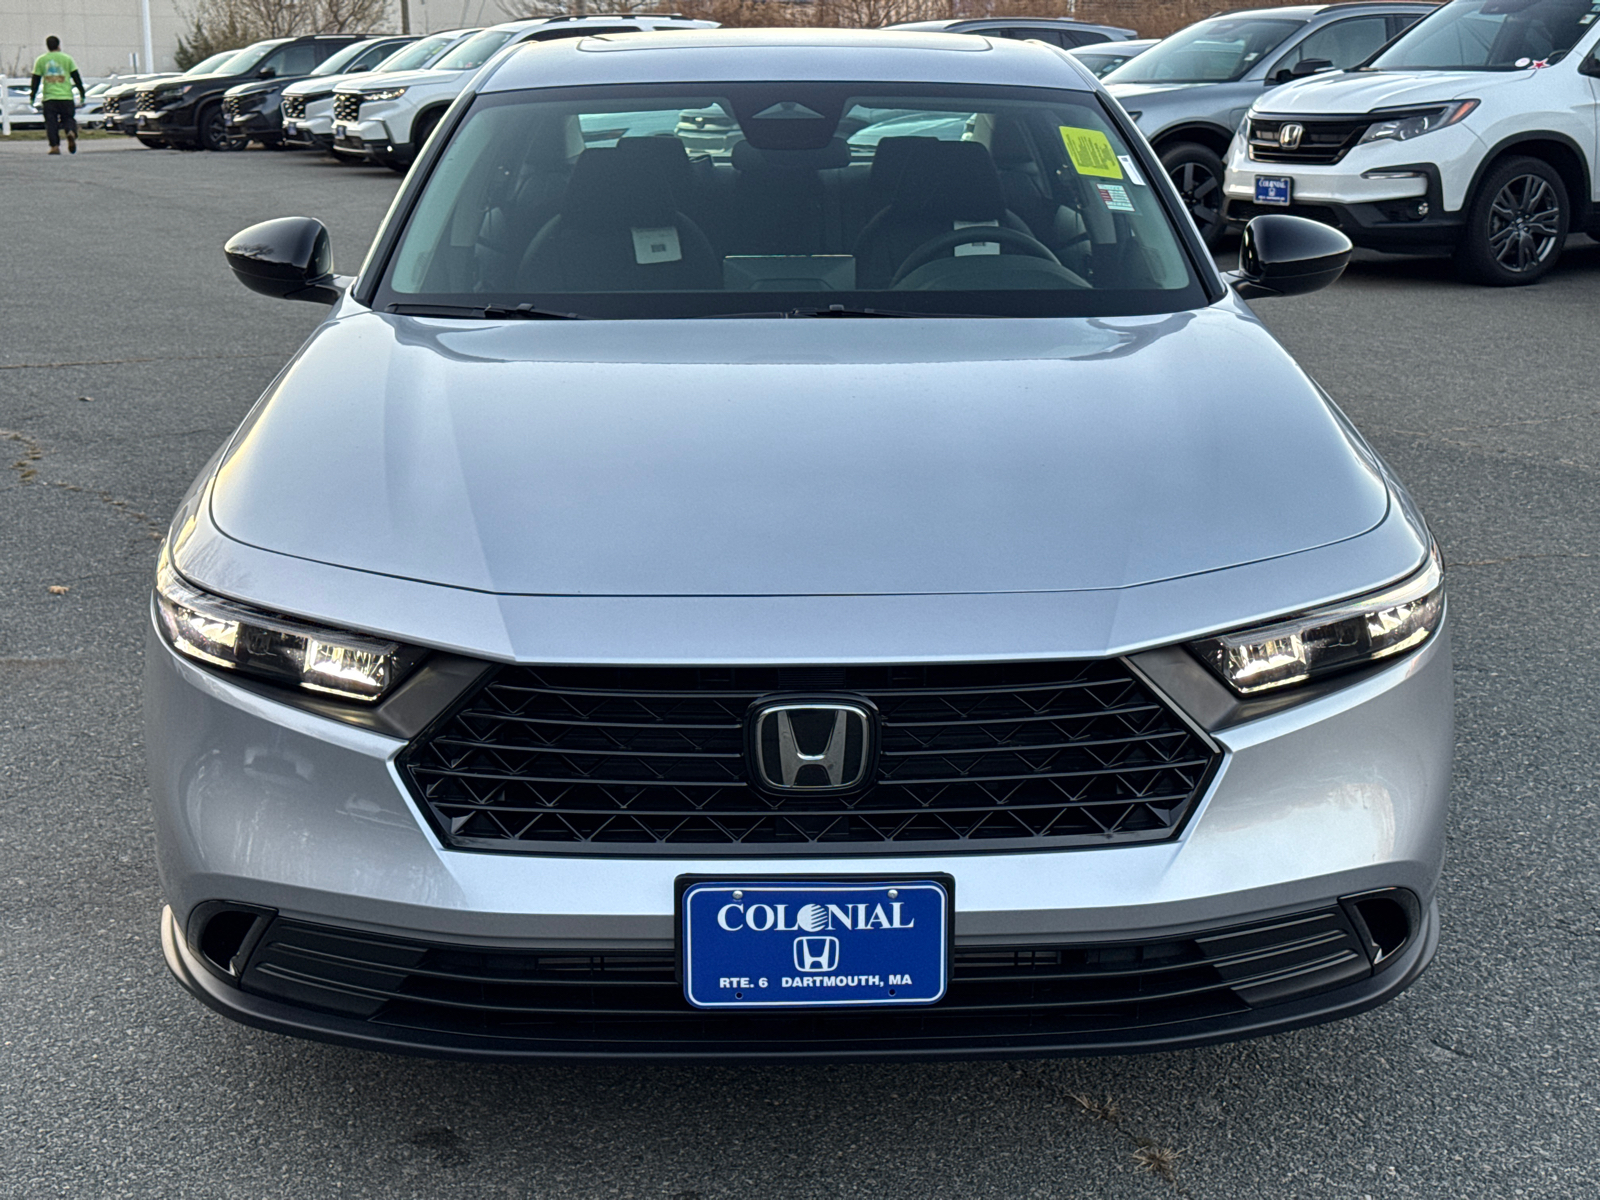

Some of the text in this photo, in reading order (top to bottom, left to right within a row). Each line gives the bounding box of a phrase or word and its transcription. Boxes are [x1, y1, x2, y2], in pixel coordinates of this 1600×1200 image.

[717, 902, 915, 932] COLONIAL
[719, 974, 912, 988] RTE. 6 DARTMOUTH, MA
